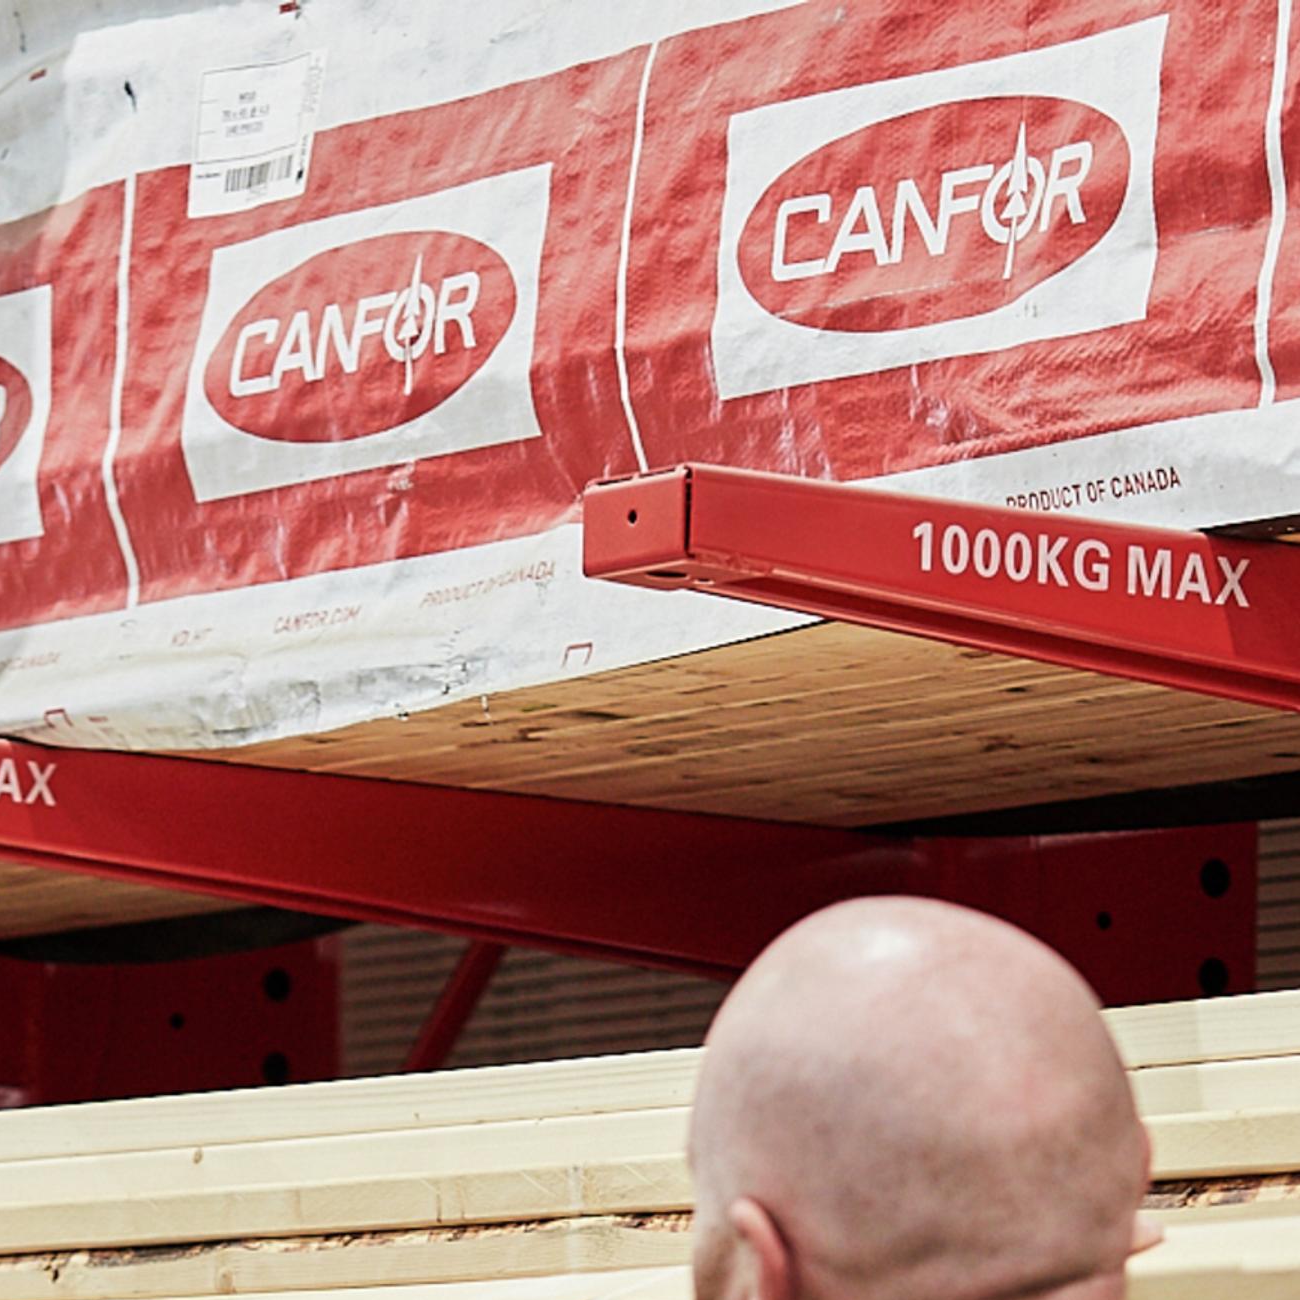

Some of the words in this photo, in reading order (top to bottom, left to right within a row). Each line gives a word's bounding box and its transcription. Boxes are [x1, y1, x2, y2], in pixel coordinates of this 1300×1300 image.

[771, 140, 1095, 283] CANFOR
[229, 272, 481, 397] CANFOR
[1006, 484, 1081, 511] PRODUCT
[1086, 479, 1105, 504] OF
[1110, 466, 1182, 500] CANADA
[911, 521, 1111, 592] 1000KG
[1127, 545, 1250, 608] MAX
